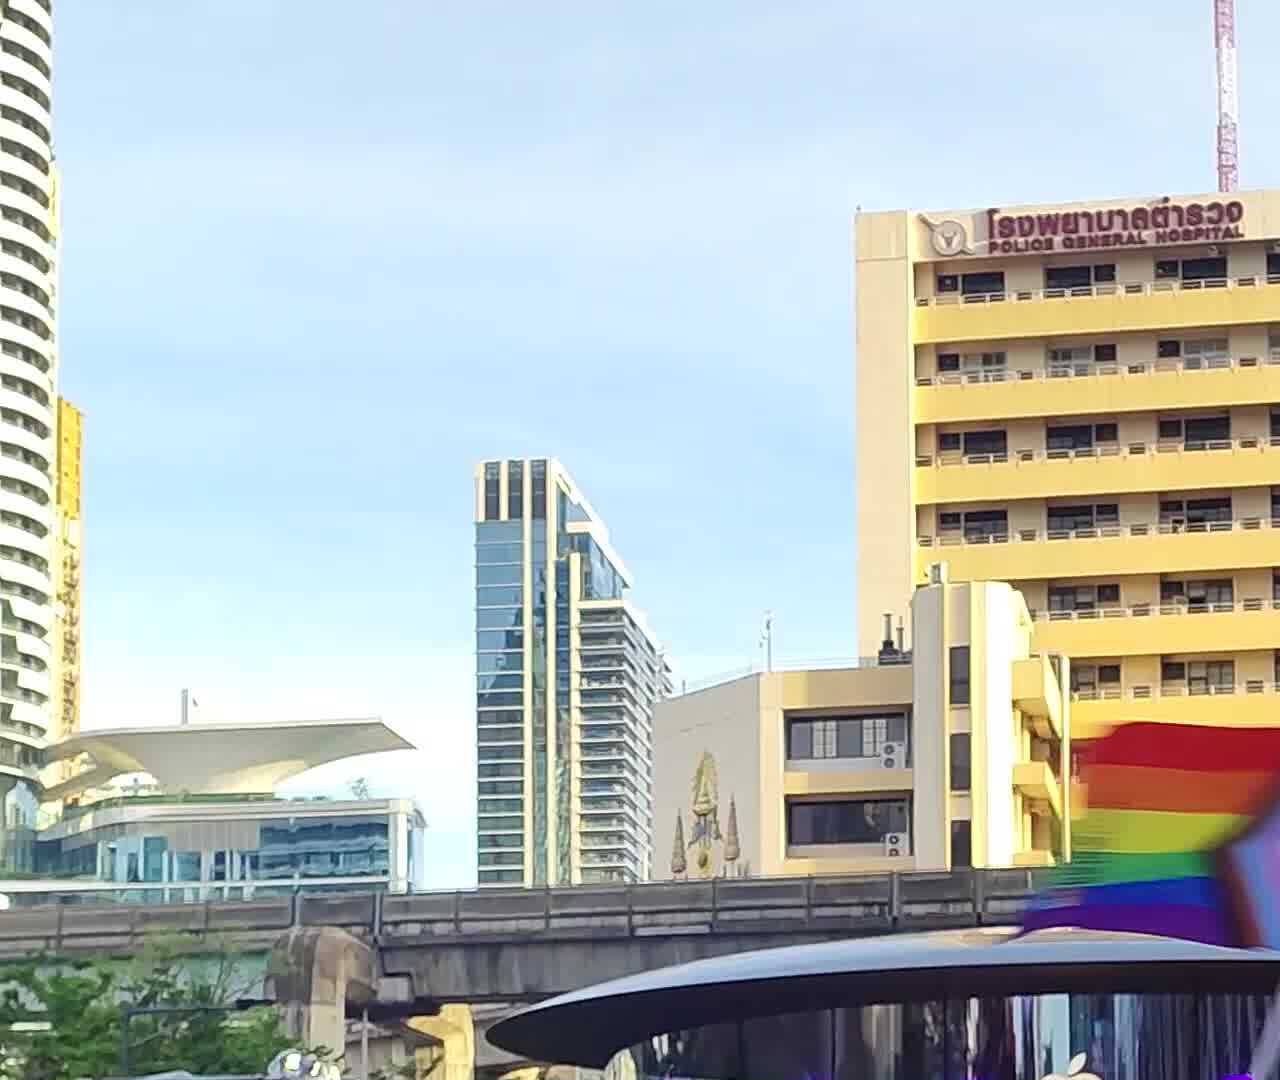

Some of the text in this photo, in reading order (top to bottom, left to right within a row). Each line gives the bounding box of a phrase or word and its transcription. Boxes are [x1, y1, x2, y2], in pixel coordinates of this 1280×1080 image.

[987, 196, 1244, 240] โรงพยาบาลตำรวจ
[988, 225, 1245, 255] POLICE GENERAL HOSPITAL
